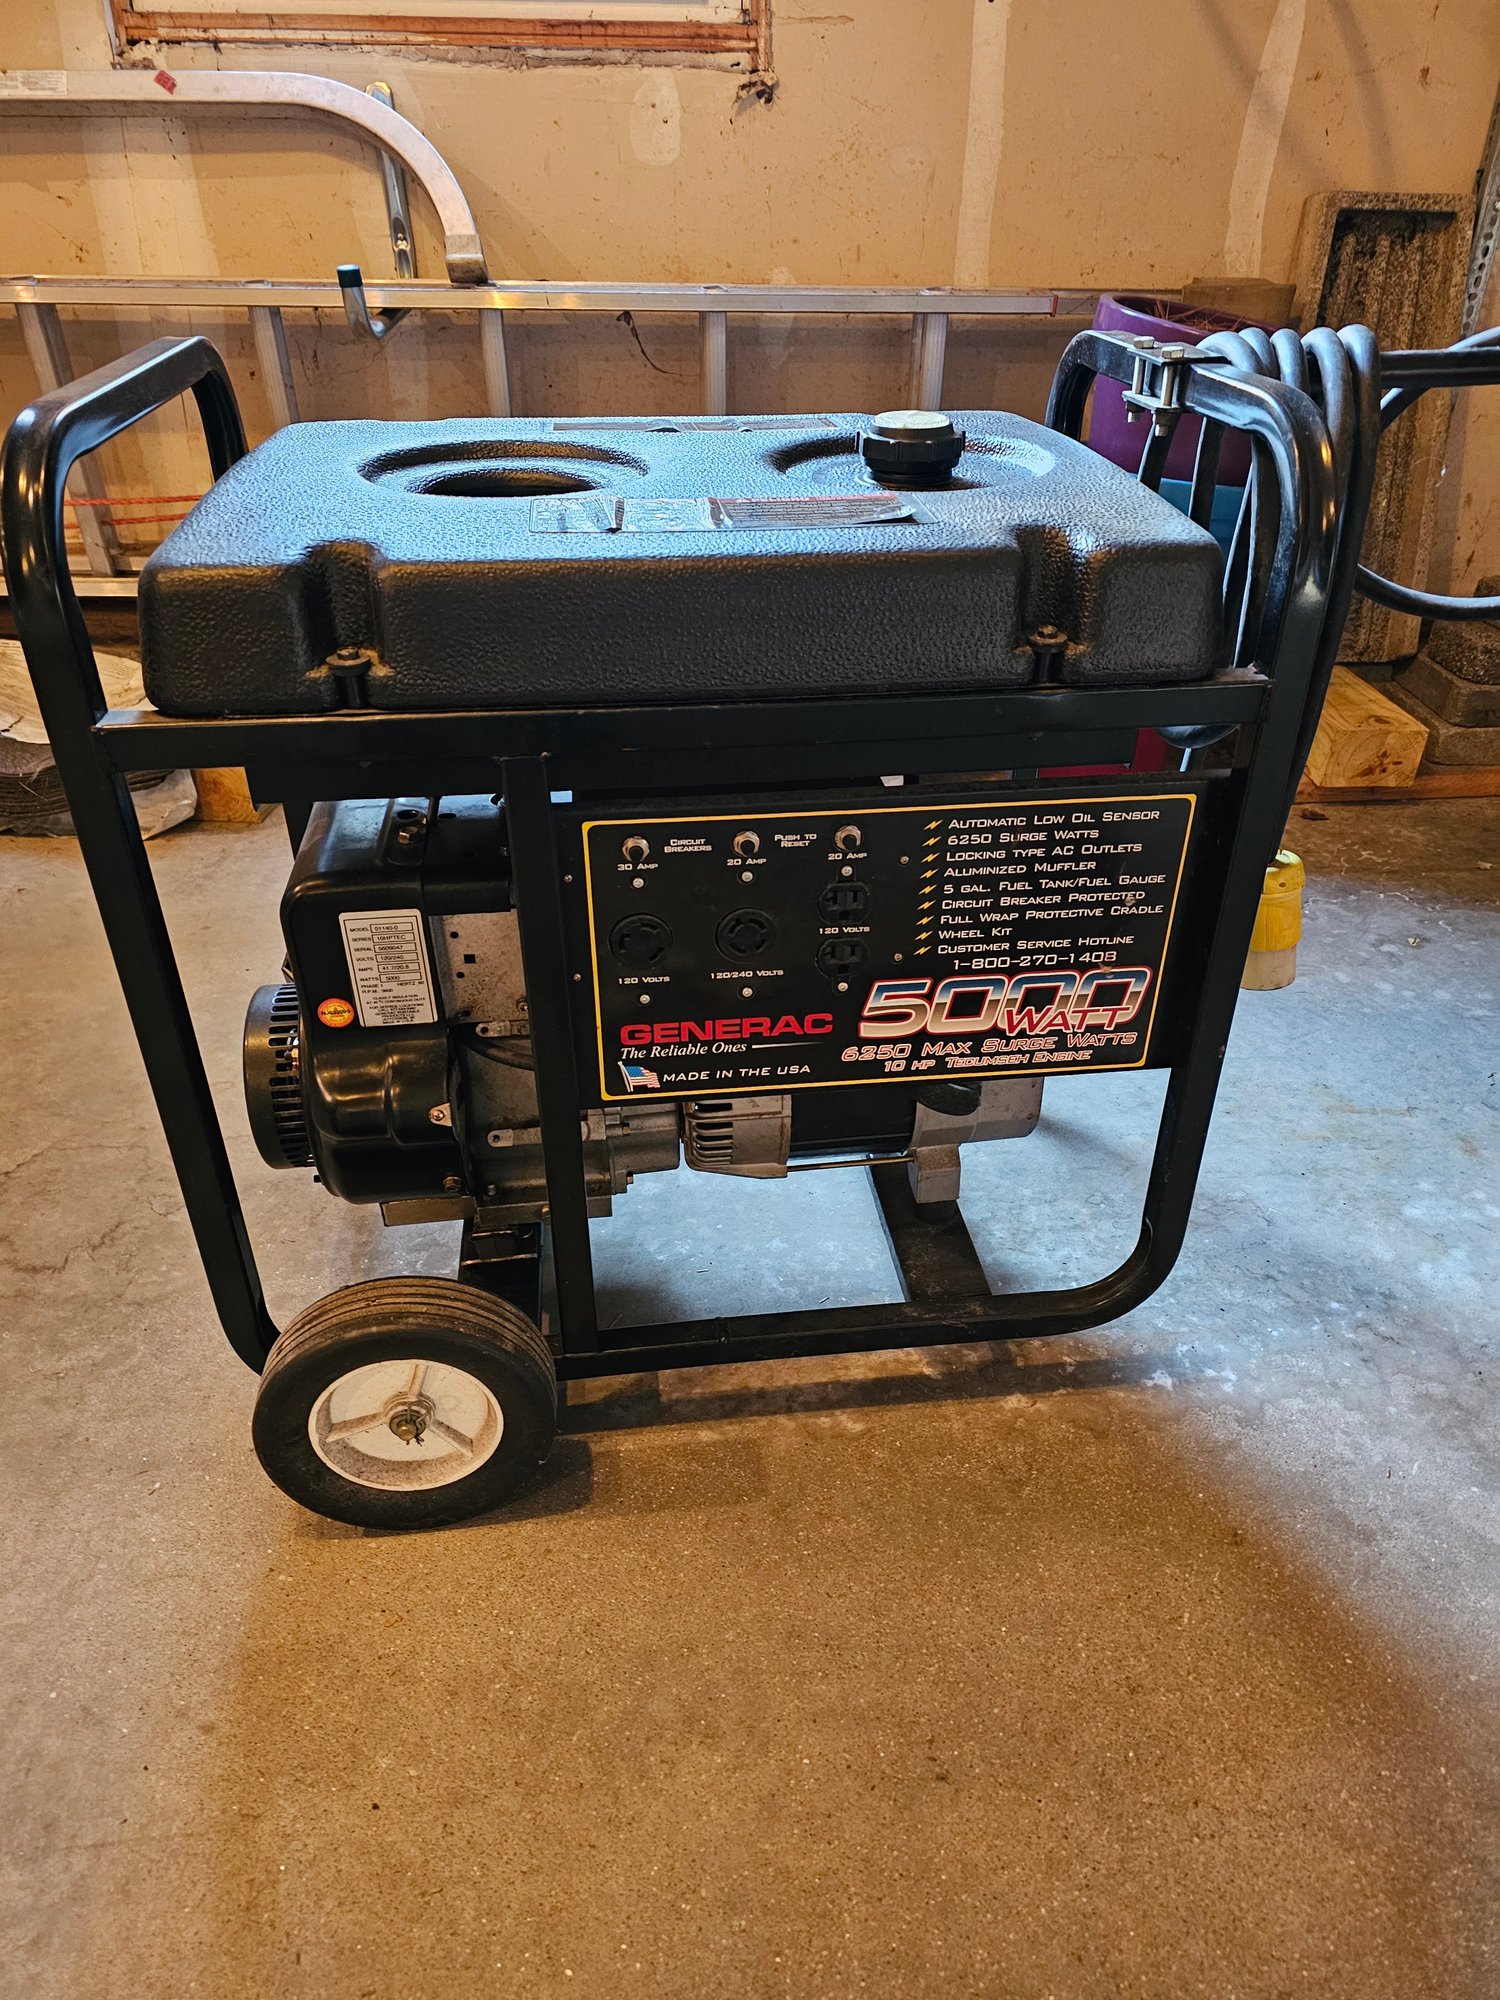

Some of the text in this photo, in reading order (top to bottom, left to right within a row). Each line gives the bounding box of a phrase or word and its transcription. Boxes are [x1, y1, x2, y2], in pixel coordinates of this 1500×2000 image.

[949, 810, 1160, 829] AUTOMATIC LOW OIL SENSOR
[670, 838, 706, 846] CIRCUIT
[781, 840, 810, 848] RESET
[948, 830, 1099, 846] 6250 SURGE WATTS
[664, 845, 713, 853] BREAKERS
[846, 852, 868, 860] AMP
[947, 843, 1142, 862] LOCKING TYPE AC OUTLETS
[617, 862, 659, 871] 30 AMP
[726, 858, 742, 866] 20
[944, 861, 1096, 877] ALUMINIZED MUFFLER
[944, 874, 1166, 894] 5 GAL. FUEL TANK/FUEL GAUGE
[942, 890, 1145, 910] CIRCUIT BREAKER PROTECTED
[940, 905, 1164, 925] FULL WRAP PROTECTIVE CRADLE
[938, 927, 1013, 940] WHEEL KIT
[937, 936, 1134, 955] CUSTOMER SERVICE HOTLINE
[953, 951, 1117, 970] 1-800-270-1408
[618, 977, 639, 985] 120
[710, 968, 784, 980] 120/240 VOLTS
[858, 967, 1152, 1039] 5000
[620, 1013, 833, 1046] GENERAC
[1004, 1005, 1132, 1036] WATT
[620, 1041, 747, 1060] The Reliable Ones
[841, 1031, 1138, 1062] 6250 MAX SURGE WATTS
[884, 1049, 1093, 1072] 10 HP TECUMSEH ENGINE
[663, 1064, 811, 1083] MADE IN THE USA
